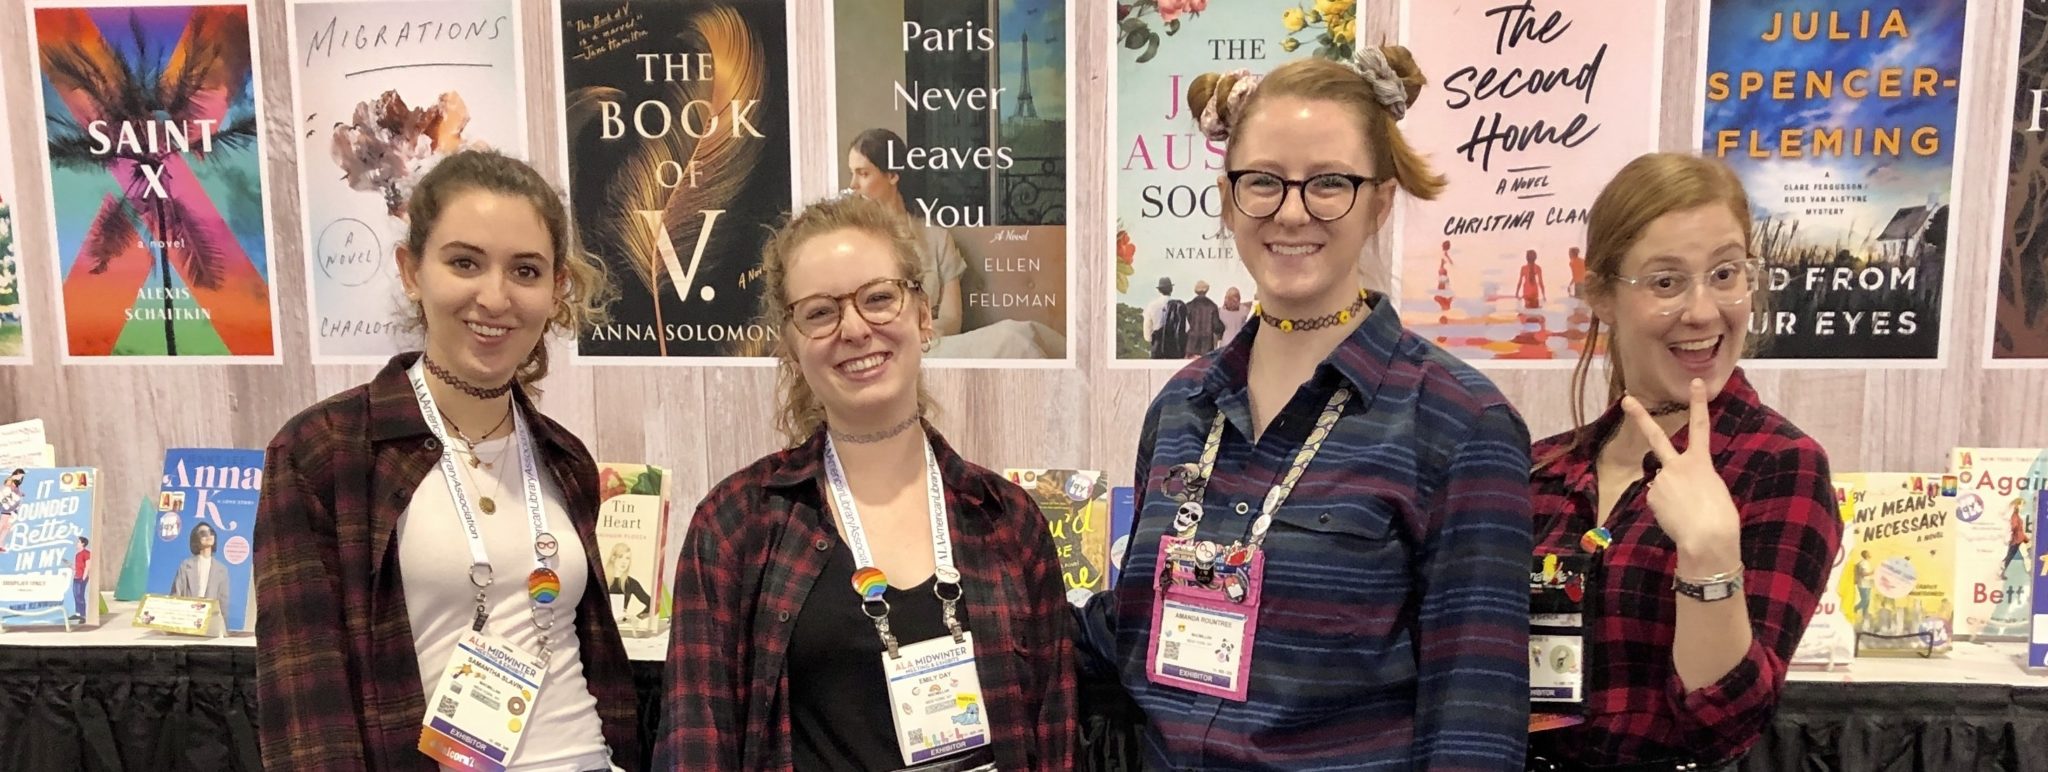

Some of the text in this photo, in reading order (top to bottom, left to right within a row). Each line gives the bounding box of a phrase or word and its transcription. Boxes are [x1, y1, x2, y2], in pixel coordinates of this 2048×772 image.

[903, 21, 995, 52] Paris
[1486, 0, 1573, 56] The
[1761, 9, 1910, 42] JULIA
[306, 15, 507, 66] MIGRATIONS
[1208, 39, 1266, 60] THE
[636, 53, 713, 82] THE
[894, 80, 1007, 112] Never
[1707, 67, 1957, 101] SPENCER-
[599, 98, 765, 140] BOOK
[88, 119, 218, 155] SAINT
[1456, 110, 1601, 170] Home
[1717, 127, 1940, 158] FLEMING
[887, 139, 1014, 171] Leaves
[142, 164, 168, 199] X
[656, 160, 704, 189] OF
[1496, 175, 1549, 194] A NOVEL
[916, 197, 984, 229] You
[1444, 210, 1535, 236] CHRISTINA
[137, 237, 185, 249] a novel
[345, 231, 354, 247] A
[989, 229, 1029, 243] A Novel
[325, 250, 372, 268] NOVEL
[984, 257, 1041, 273] ELLEN
[1165, 247, 1233, 260] NATALIE
[739, 272, 746, 289] A
[1805, 267, 1916, 291] FROM
[137, 286, 190, 301] ALEXIS
[969, 293, 1056, 308] FELDMAN
[124, 307, 212, 321] SCHAITKIN
[1815, 311, 1917, 335] EYES
[591, 324, 781, 341] ANNA SOLOMON
[162, 457, 263, 491] Anna
[36, 479, 55, 500] IT
[18, 495, 80, 521] OUNDED
[194, 488, 238, 532] K
[611, 500, 635, 513] Tin
[1881, 495, 1936, 518] MEANS
[7, 519, 83, 551] Better
[603, 515, 642, 530] Heart
[1863, 511, 1948, 543] NECESSARY
[15, 547, 67, 572] IN MY
[1175, 612, 1233, 629] AMANDA ROUNTREE
[468, 636, 537, 678] ALA MIDWINTER
[895, 646, 967, 672] ALA MIDWINTER
[468, 656, 524, 690] SAMANTHA SLAVIN
[918, 671, 952, 685] EMILY DAY
[1178, 669, 1213, 683] EXHIBITOR
[449, 728, 487, 751] EXHIBITOR
[930, 742, 967, 756] EXHIBITOR
